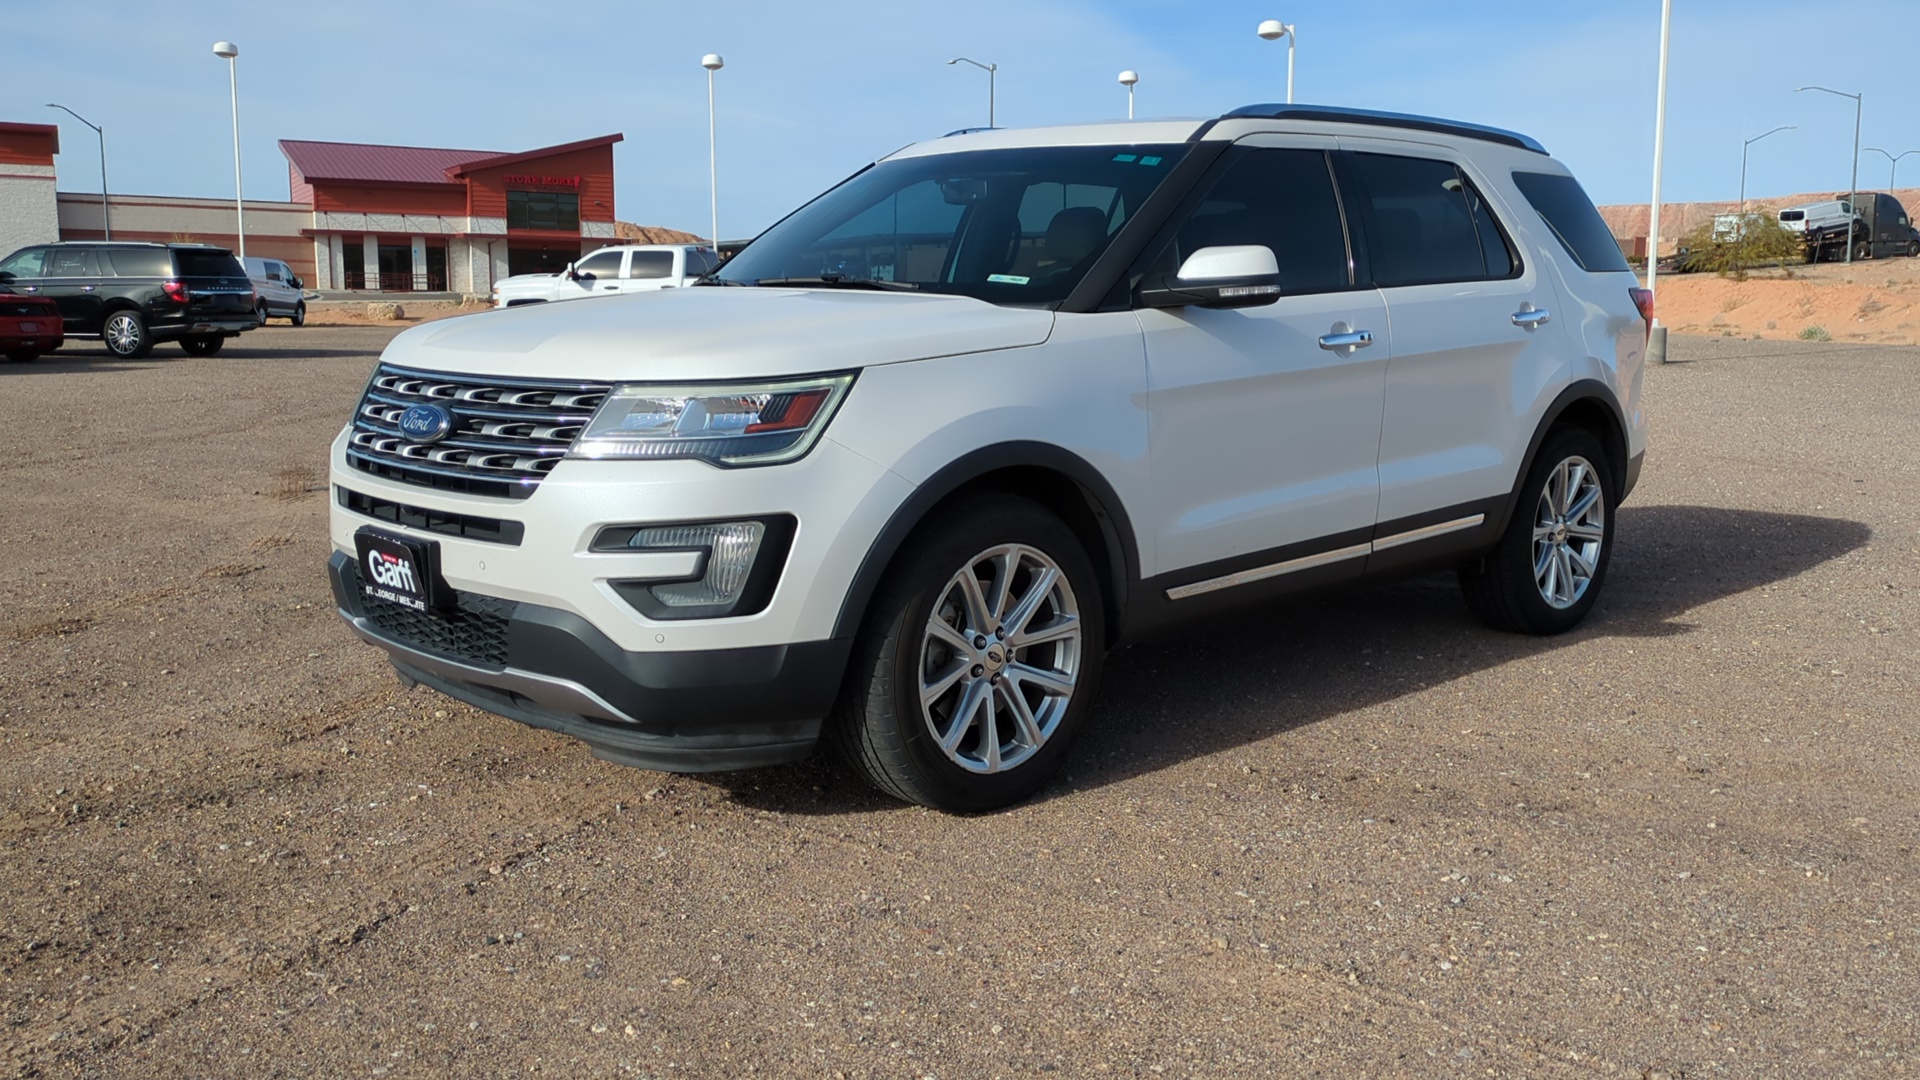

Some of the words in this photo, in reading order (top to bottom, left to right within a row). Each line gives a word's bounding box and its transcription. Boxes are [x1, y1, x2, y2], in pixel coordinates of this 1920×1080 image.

[503, 174, 539, 185] STORE
[403, 408, 433, 431] Ford
[368, 549, 416, 593] Garff
